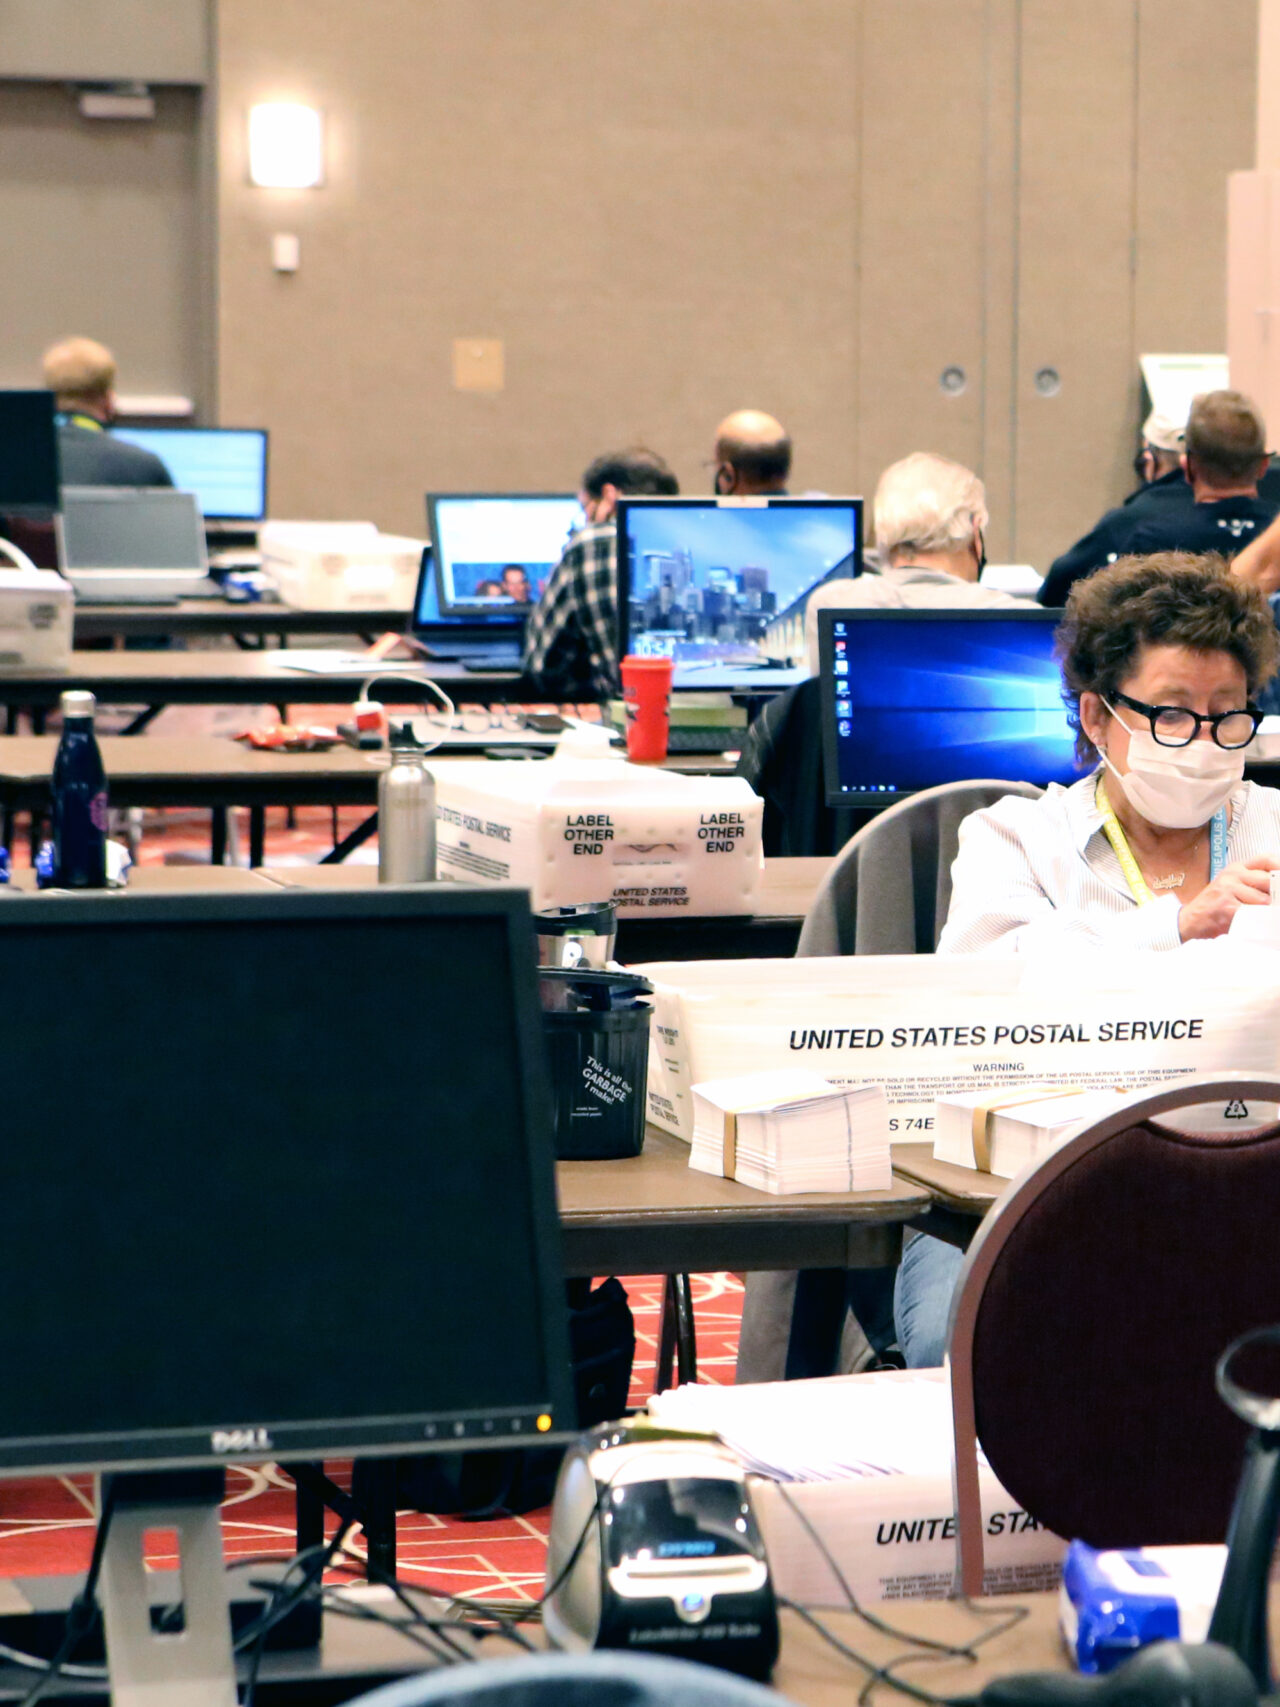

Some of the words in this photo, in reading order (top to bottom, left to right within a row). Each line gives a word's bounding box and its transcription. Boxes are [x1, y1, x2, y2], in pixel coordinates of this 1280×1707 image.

[566, 815, 614, 827] LABEL
[700, 813, 745, 825] LABEL
[564, 828, 614, 841] OTHER
[698, 826, 745, 839] OTHER
[573, 843, 603, 855] END
[706, 841, 735, 853] END
[613, 887, 649, 897] UNITED
[650, 886, 688, 897] STATES
[648, 897, 691, 907] SERVICE
[790, 1029, 884, 1050] UNITED
[891, 1026, 986, 1048] STATES
[994, 1023, 1091, 1045] POSTAL
[1098, 1019, 1204, 1042] SERVICE
[973, 1063, 1025, 1072] WARNING
[587, 1056, 603, 1072] This
[604, 1068, 612, 1078] is
[611, 1075, 622, 1085] all
[621, 1081, 633, 1093] the
[582, 1068, 627, 1102] GARBAGE
[905, 1117, 935, 1131] 74E
[212, 1428, 273, 1453] DELL
[876, 1518, 957, 1546] UNITE
